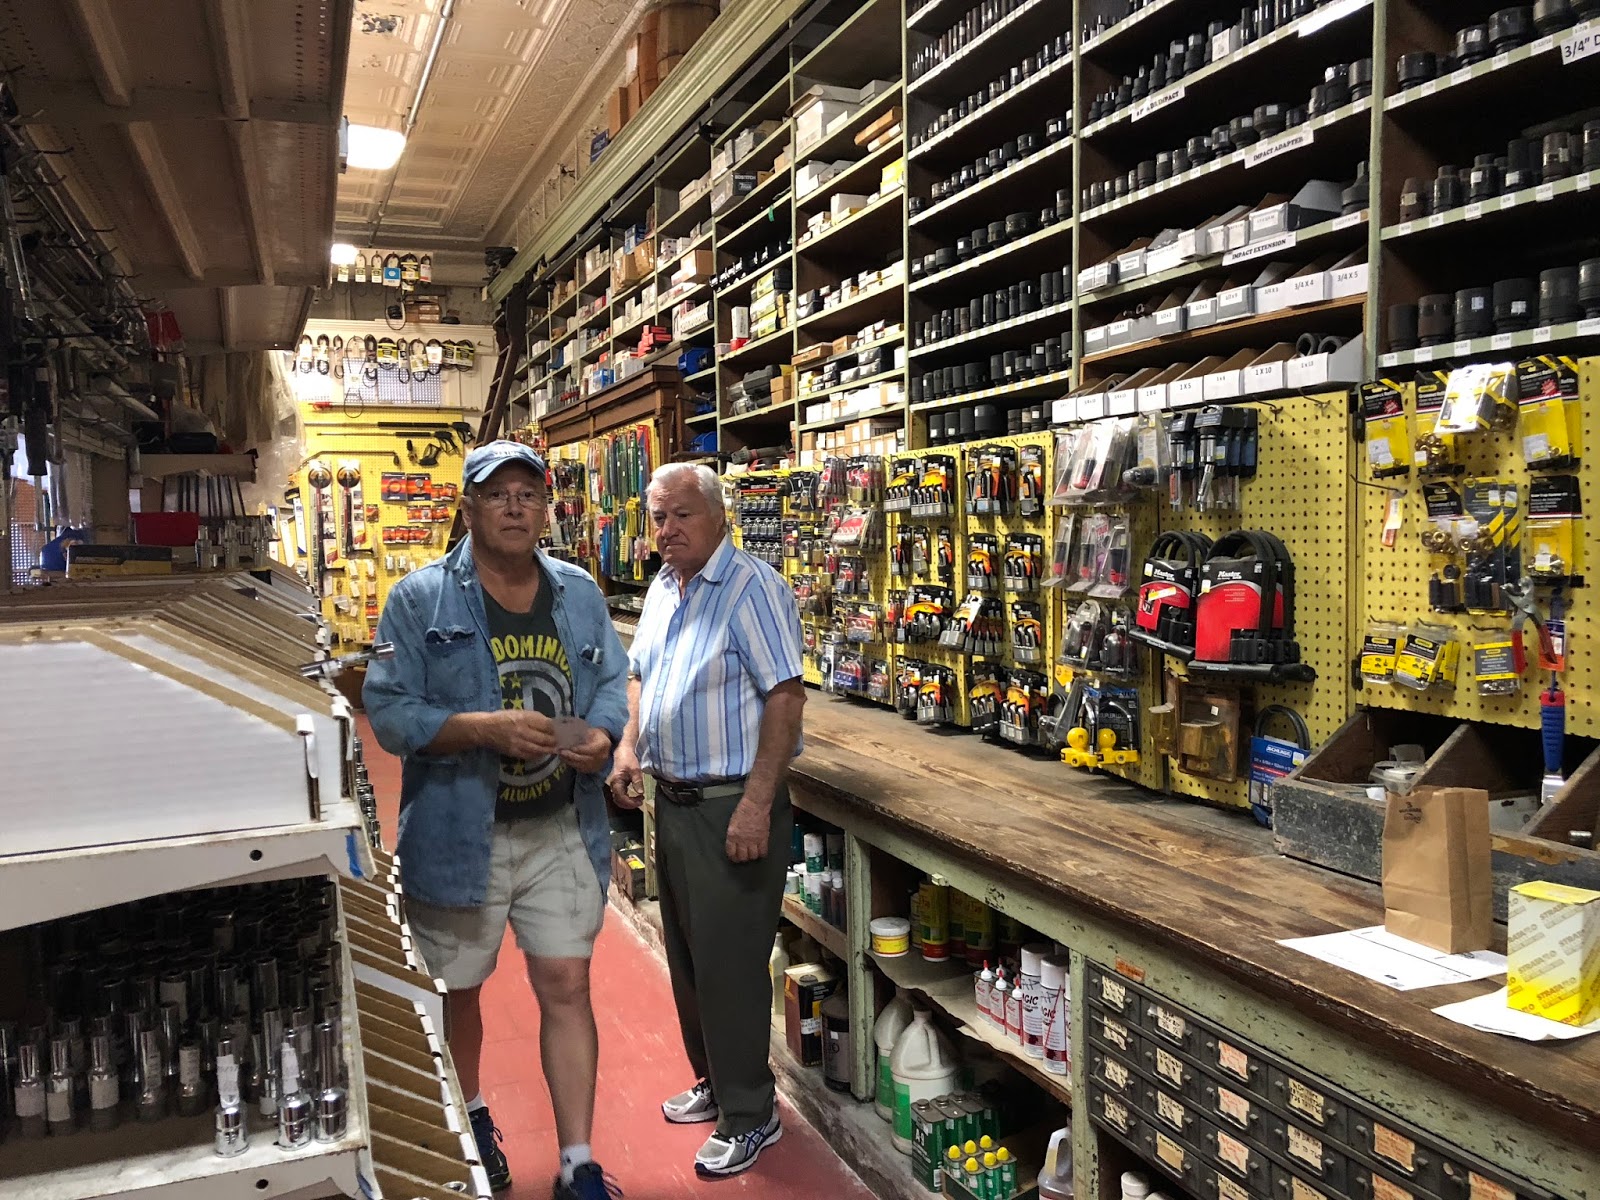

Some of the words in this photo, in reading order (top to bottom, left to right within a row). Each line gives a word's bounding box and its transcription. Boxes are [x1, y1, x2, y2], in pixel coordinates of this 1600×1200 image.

[1564, 36, 1590, 58] 3/4"
[1254, 148, 1273, 162] IMPACT
[1274, 136, 1304, 153] ADAPTER
[1232, 249, 1252, 260] IMPACT
[1254, 239, 1286, 254] EXTENSION
[1338, 273, 1348, 282] 3/4
[1295, 282, 1304, 290] 3/4
[1154, 569, 1174, 578] Master
[1267, 746, 1291, 758] SCHLAGE
